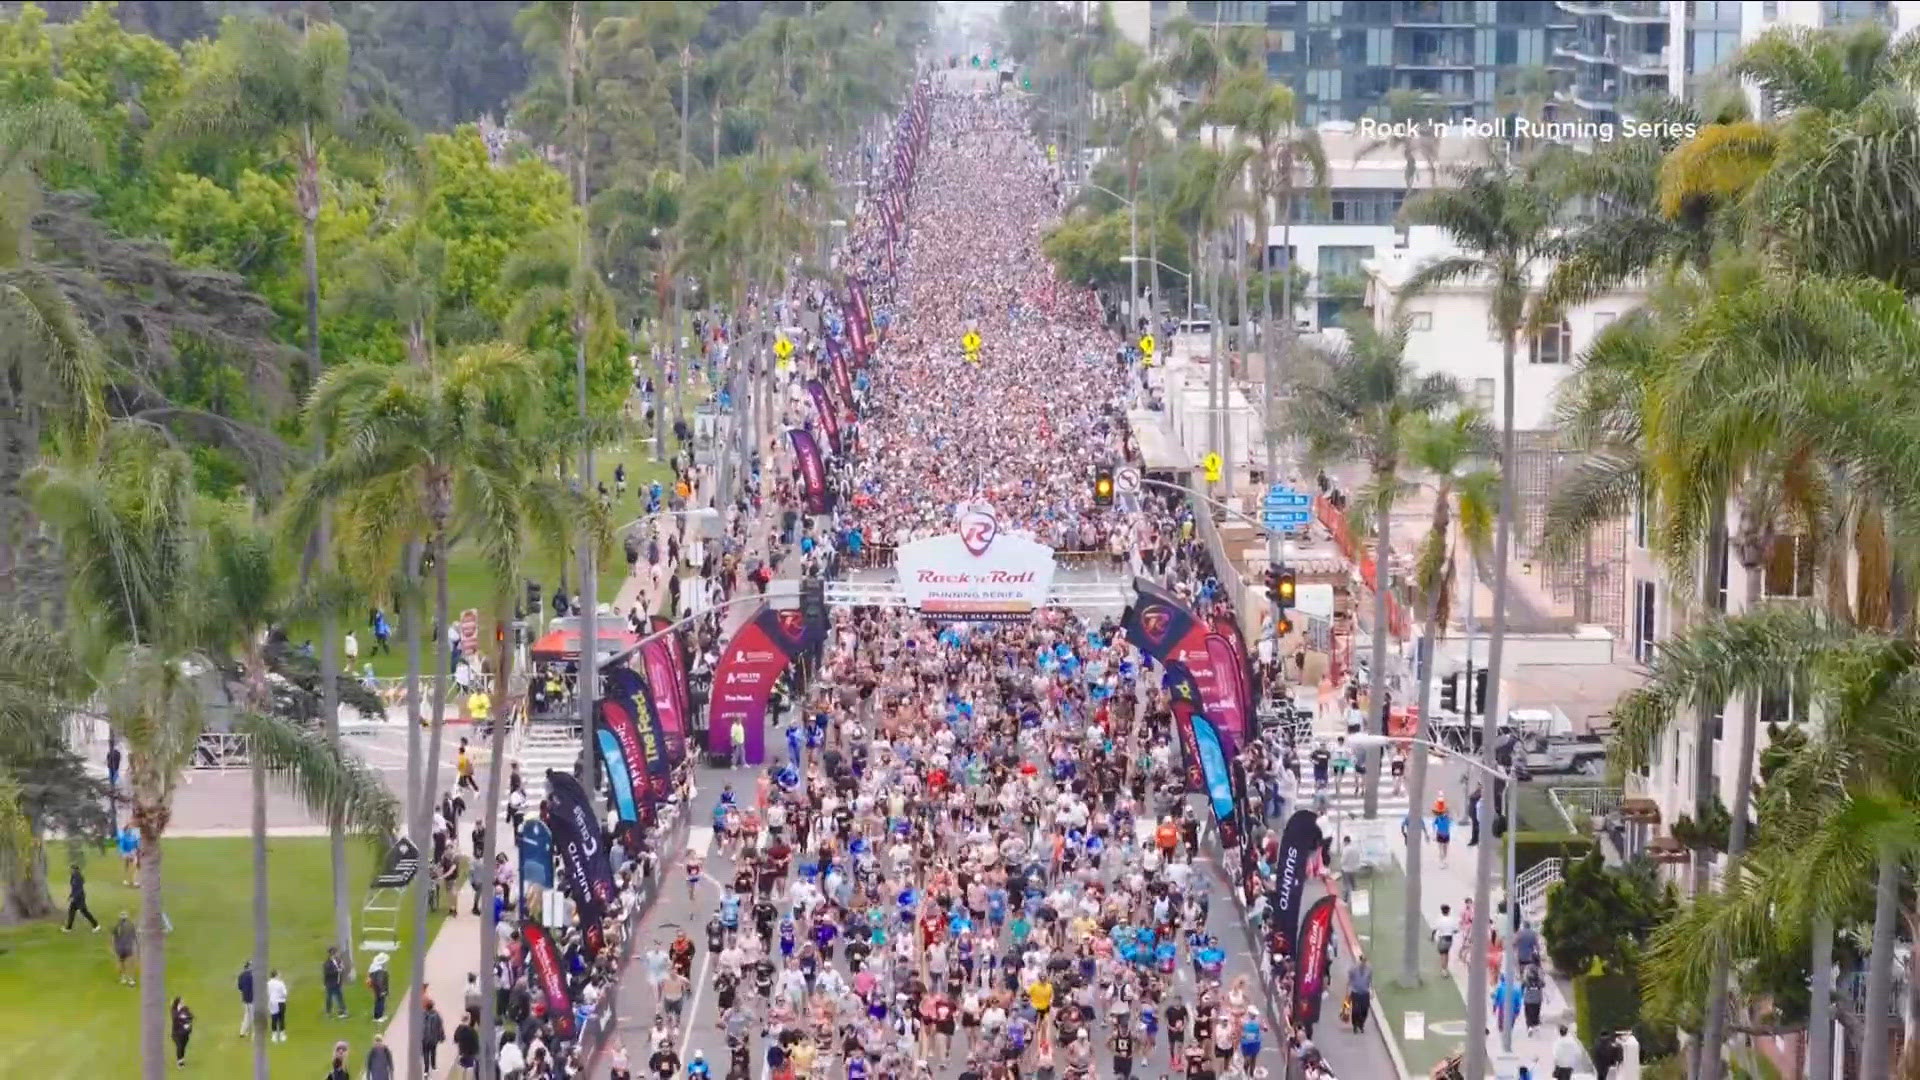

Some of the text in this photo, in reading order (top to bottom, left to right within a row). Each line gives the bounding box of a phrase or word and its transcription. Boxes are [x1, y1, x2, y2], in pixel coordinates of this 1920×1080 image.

[917, 570, 970, 583] Rock
[990, 570, 1035, 584] Roll
[928, 591, 1024, 599] RUNNING SERIES
[643, 732, 660, 762] The
[568, 841, 592, 903] SUUNTO
[1279, 846, 1298, 911] SUUNTO
